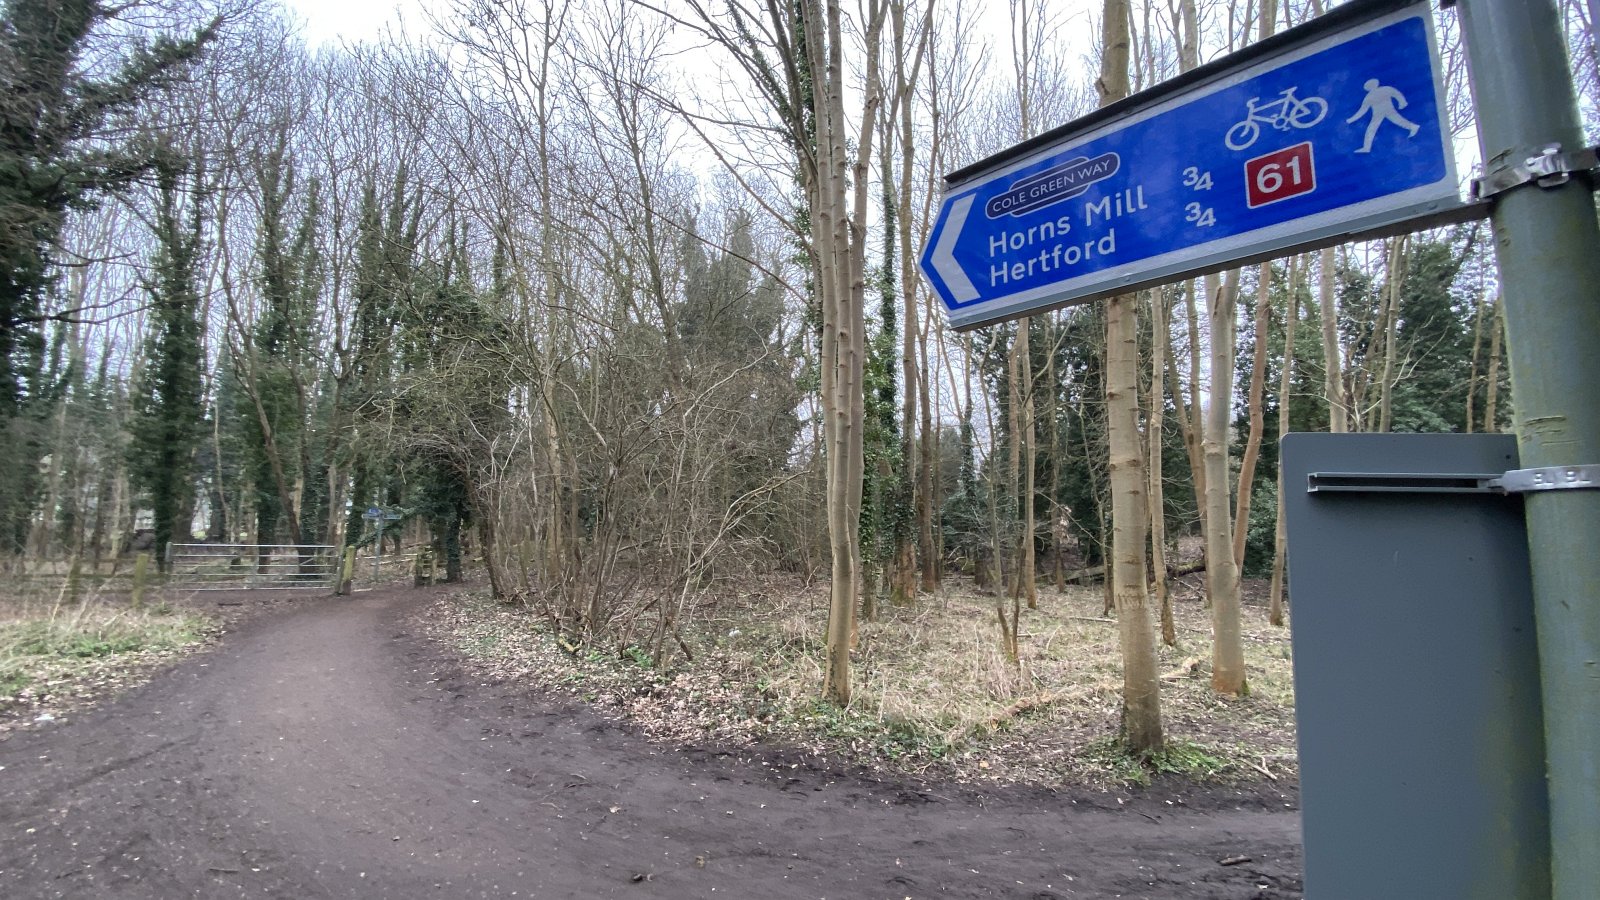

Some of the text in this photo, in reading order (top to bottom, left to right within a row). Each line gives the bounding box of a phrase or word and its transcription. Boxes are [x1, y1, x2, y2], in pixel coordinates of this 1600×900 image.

[992, 159, 1110, 212] COLE GREEN WAY
[1256, 155, 1302, 193] 61
[989, 215, 1071, 257] Horns
[1085, 185, 1148, 227] Mill
[990, 228, 1116, 287] Hertford
